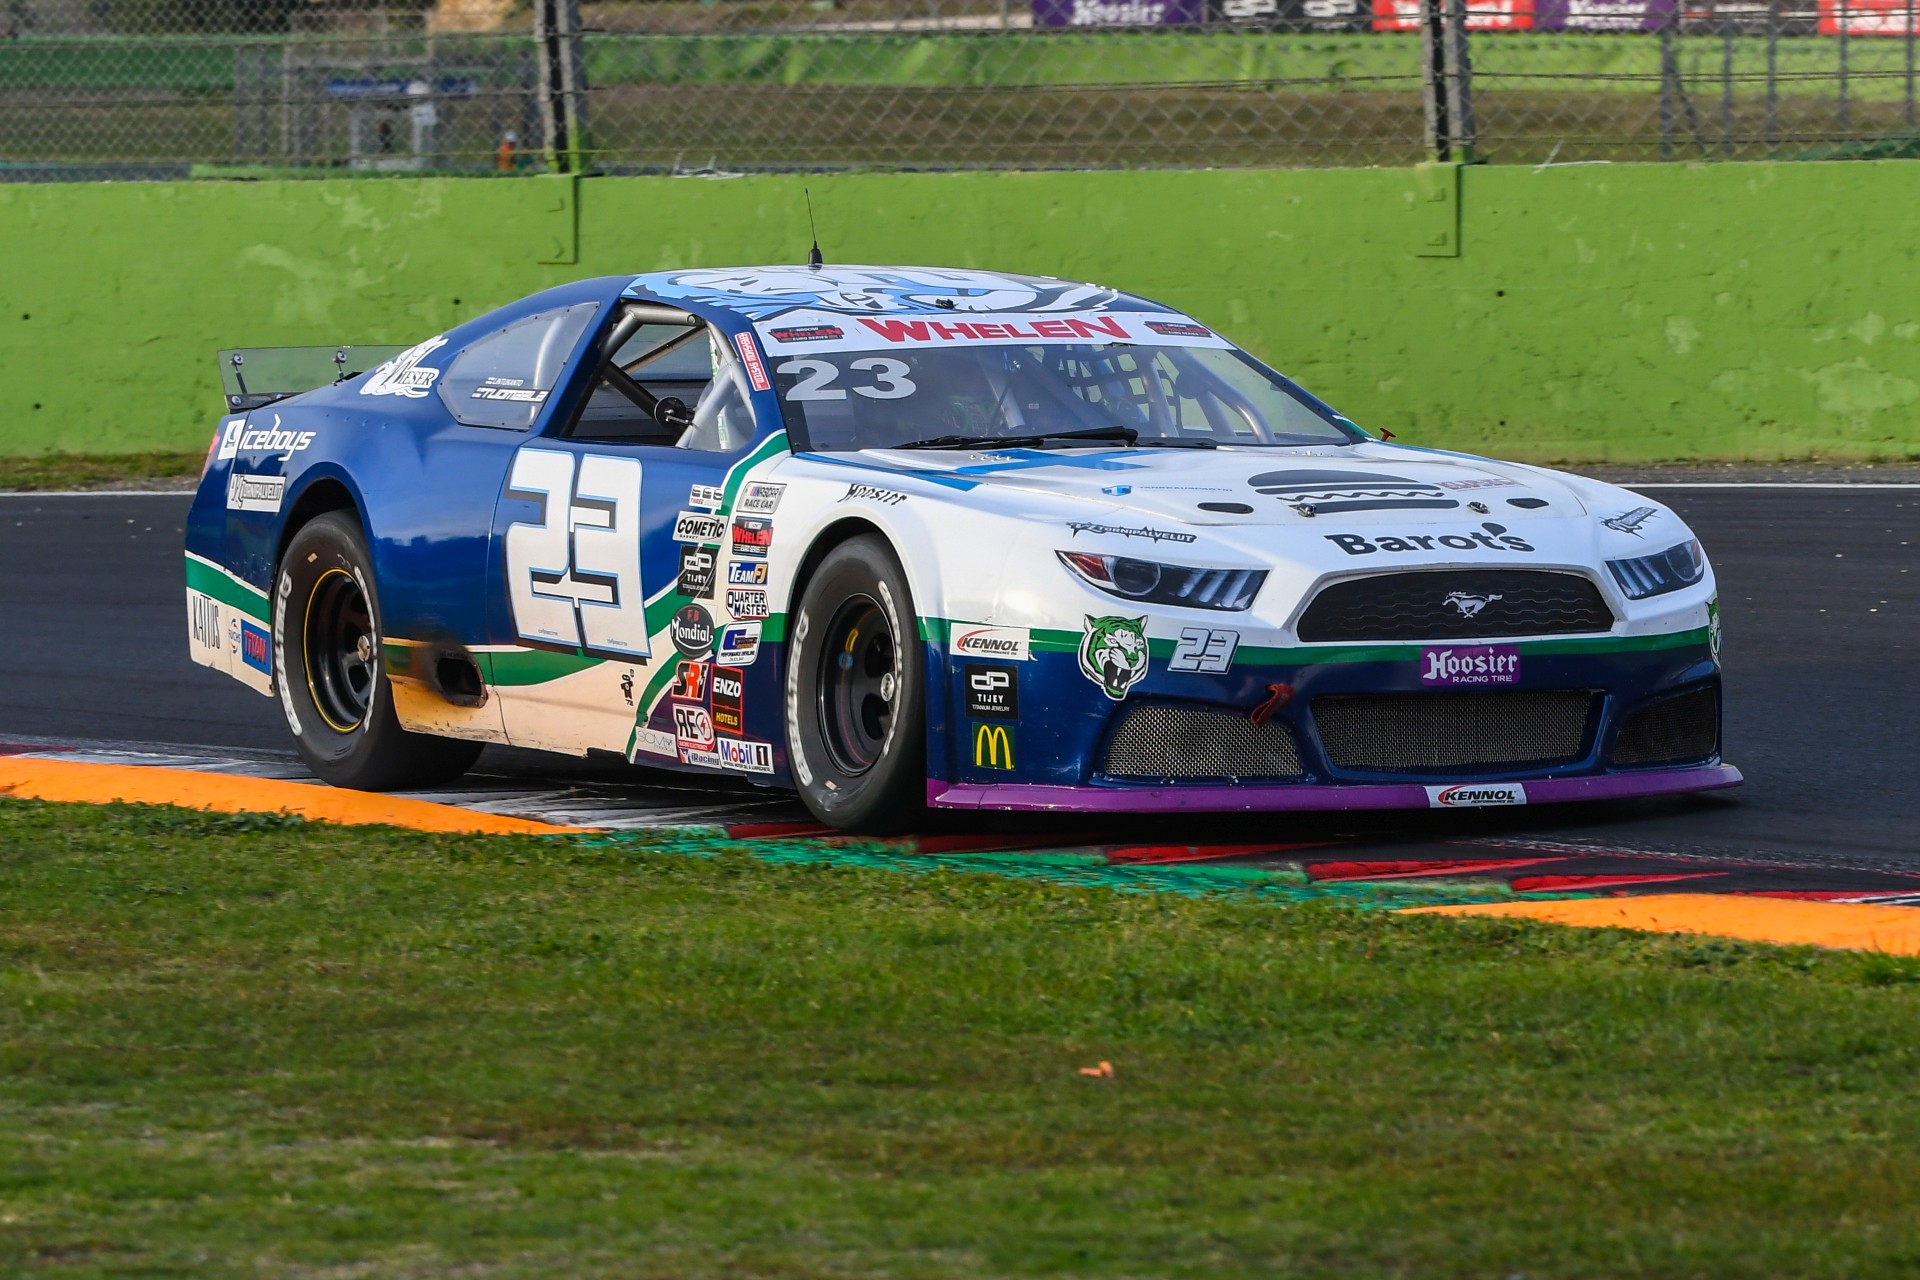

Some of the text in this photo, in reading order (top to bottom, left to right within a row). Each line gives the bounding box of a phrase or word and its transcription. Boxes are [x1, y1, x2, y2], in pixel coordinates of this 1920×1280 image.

[772, 328, 844, 339] WHELEN
[857, 316, 1132, 342] WHELEN
[776, 357, 917, 400] 23
[239, 414, 317, 461] iceboys
[744, 499, 774, 509] RACE CAR
[677, 518, 725, 538] COMETIC
[733, 525, 773, 546] WHELEN
[505, 447, 652, 662] 23
[687, 573, 707, 583] TIJEY
[727, 591, 765, 608] QUARTER
[733, 604, 767, 616] MASTER
[193, 594, 220, 649] KATTUS
[671, 616, 714, 645] Mondial
[962, 638, 1019, 651] KENNOL
[1167, 627, 1240, 674] 23
[1423, 647, 1518, 679] Hoosier
[713, 677, 741, 698] ENZO
[1453, 675, 1489, 683] RACING
[977, 693, 1004, 704] TIJEY
[715, 712, 738, 727] HOTELS
[691, 752, 720, 766] iRacing
[720, 740, 754, 764] Mobil
[1444, 790, 1516, 801] KENNOL
